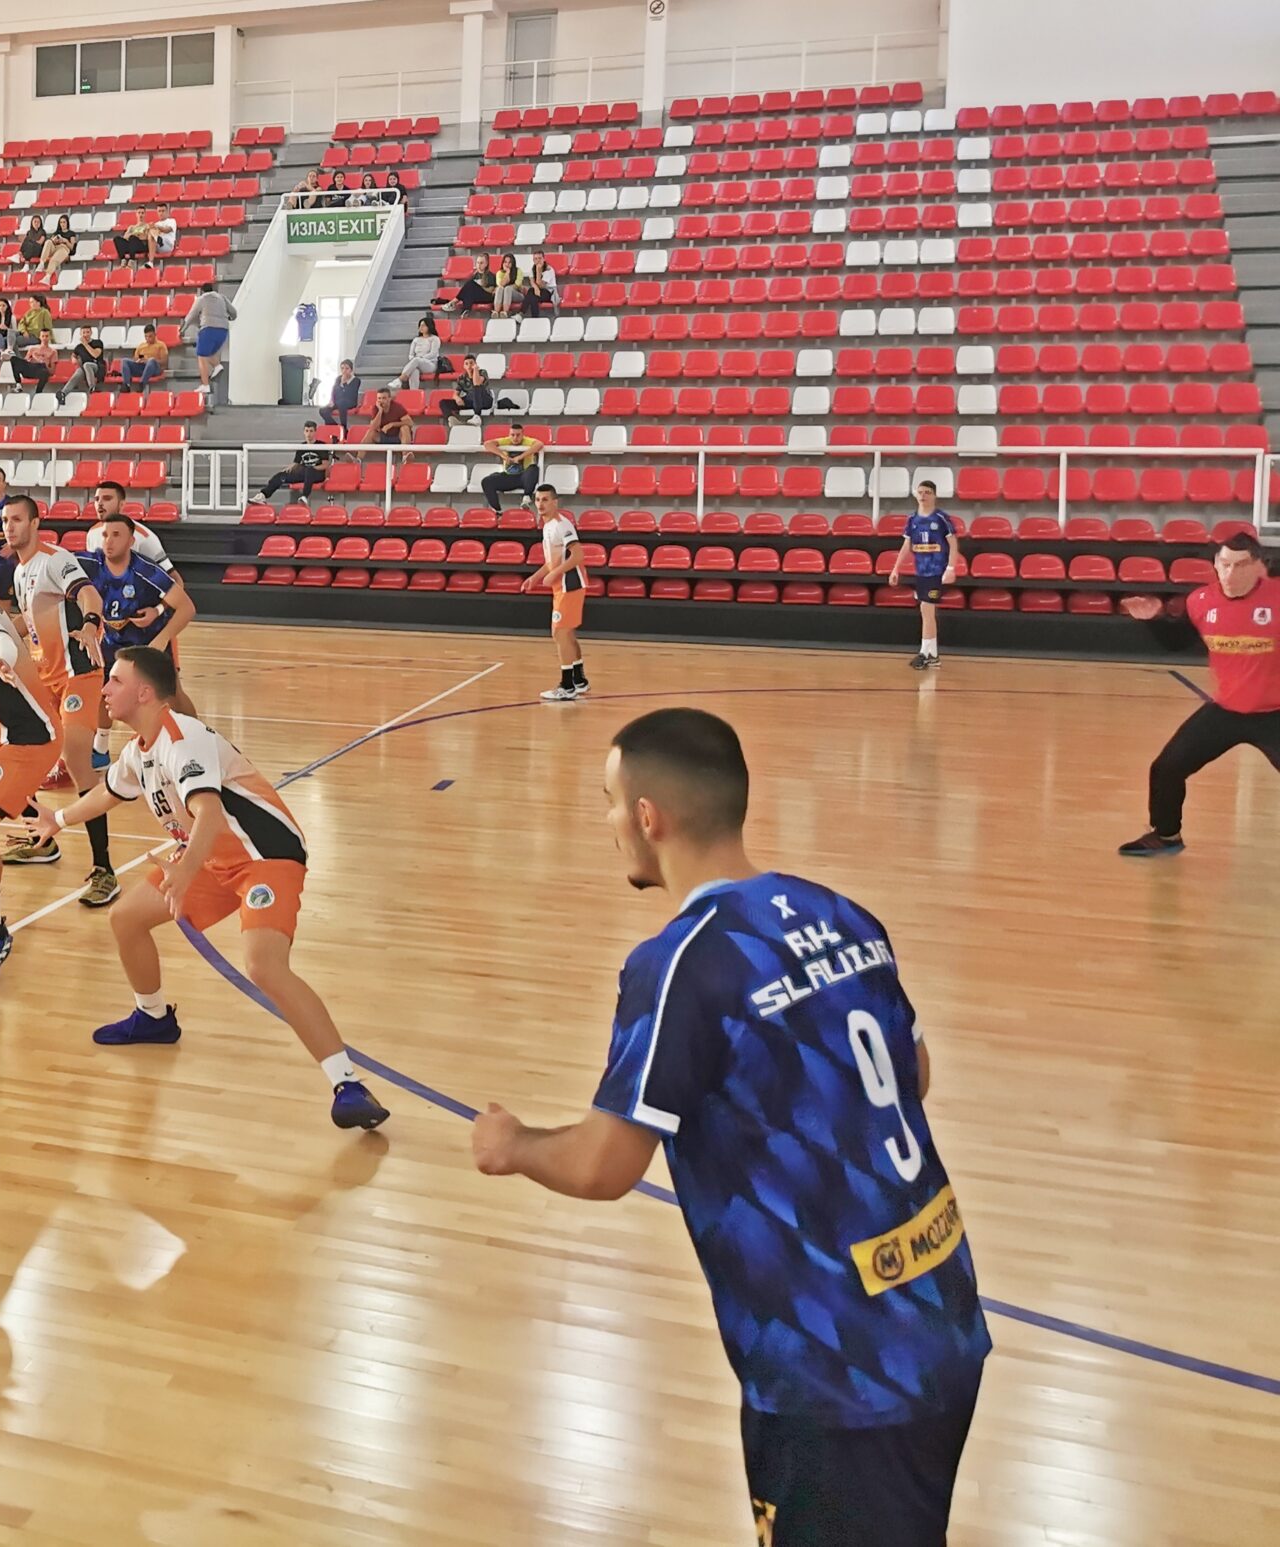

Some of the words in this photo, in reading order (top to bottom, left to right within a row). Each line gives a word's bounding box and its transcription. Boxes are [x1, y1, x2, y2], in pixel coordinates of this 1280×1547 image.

[290, 221, 335, 236] ИЗЛАЗ
[339, 219, 375, 235] EXIT
[110, 600, 120, 618] 2
[783, 920, 841, 958] RK
[847, 1009, 923, 1182] 9
